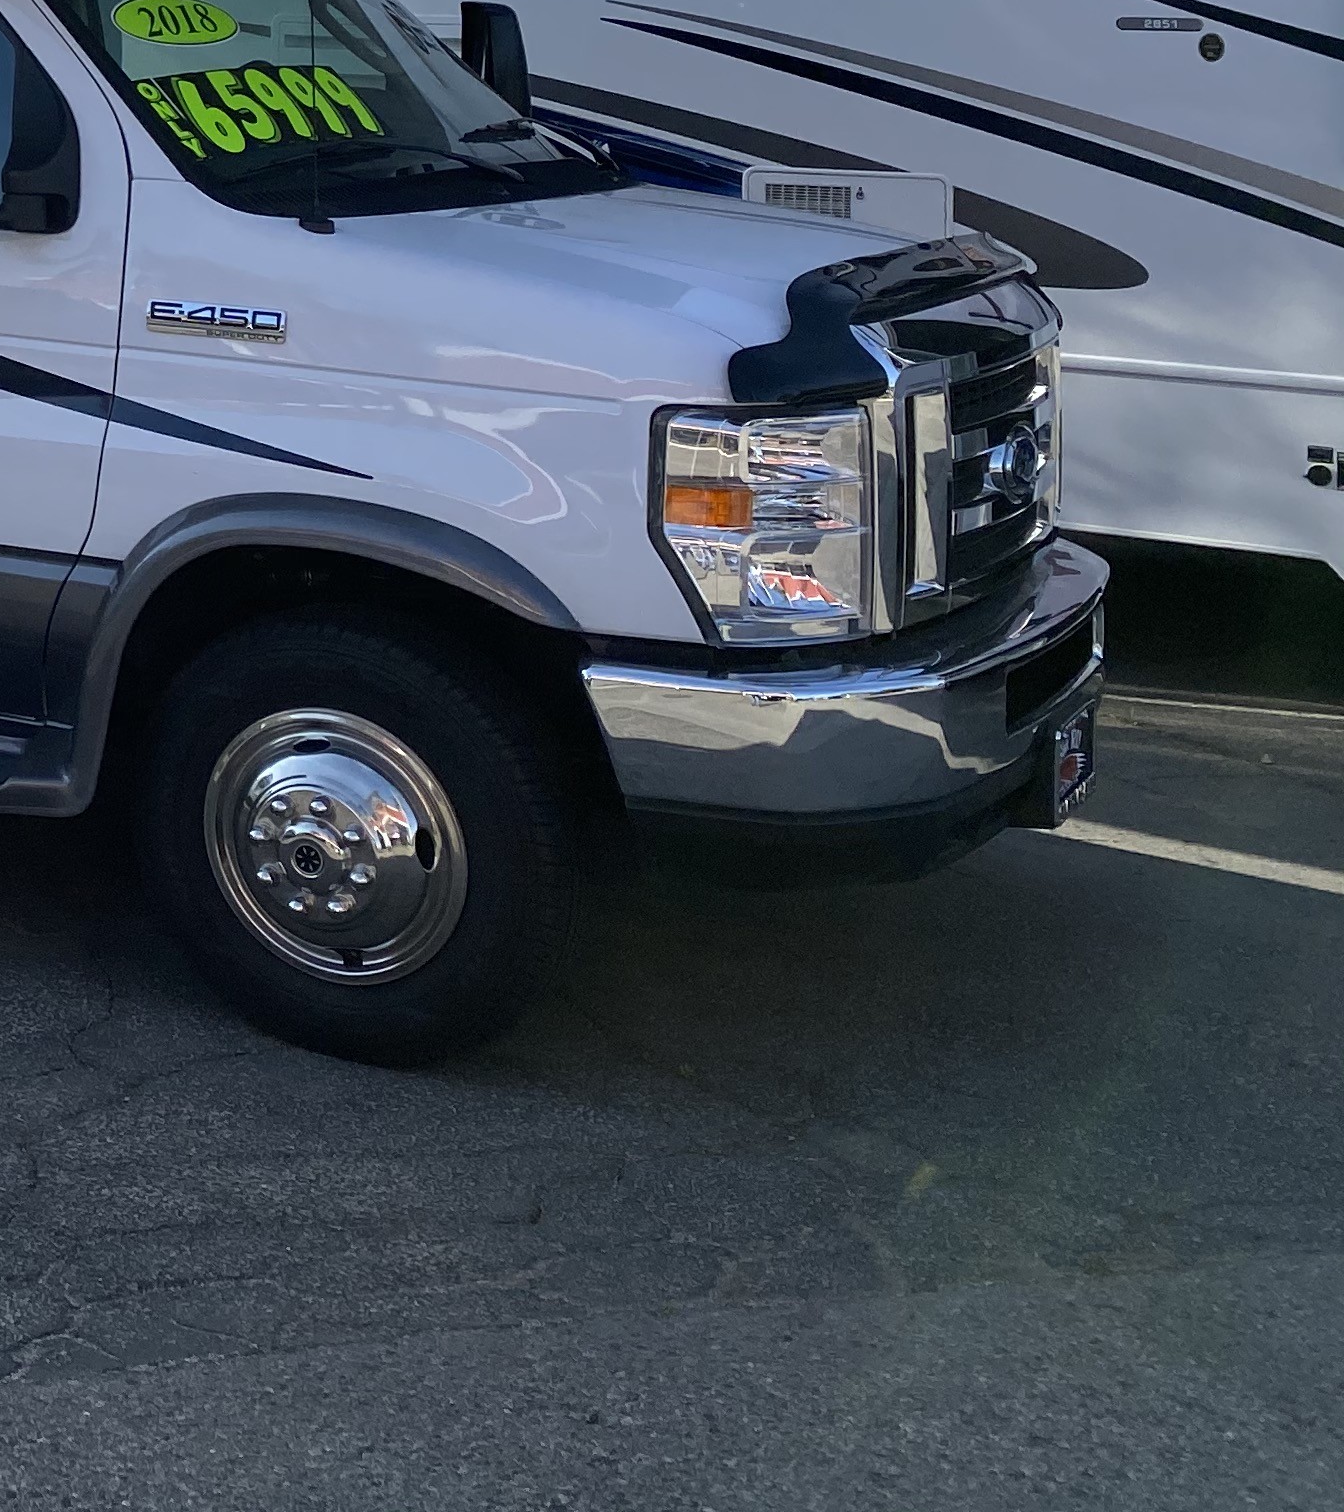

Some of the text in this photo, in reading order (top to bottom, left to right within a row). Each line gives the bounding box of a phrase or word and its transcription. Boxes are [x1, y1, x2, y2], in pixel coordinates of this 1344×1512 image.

[137, 3, 219, 38] 2018
[136, 82, 207, 159] ONLY
[172, 68, 386, 154] 65999
